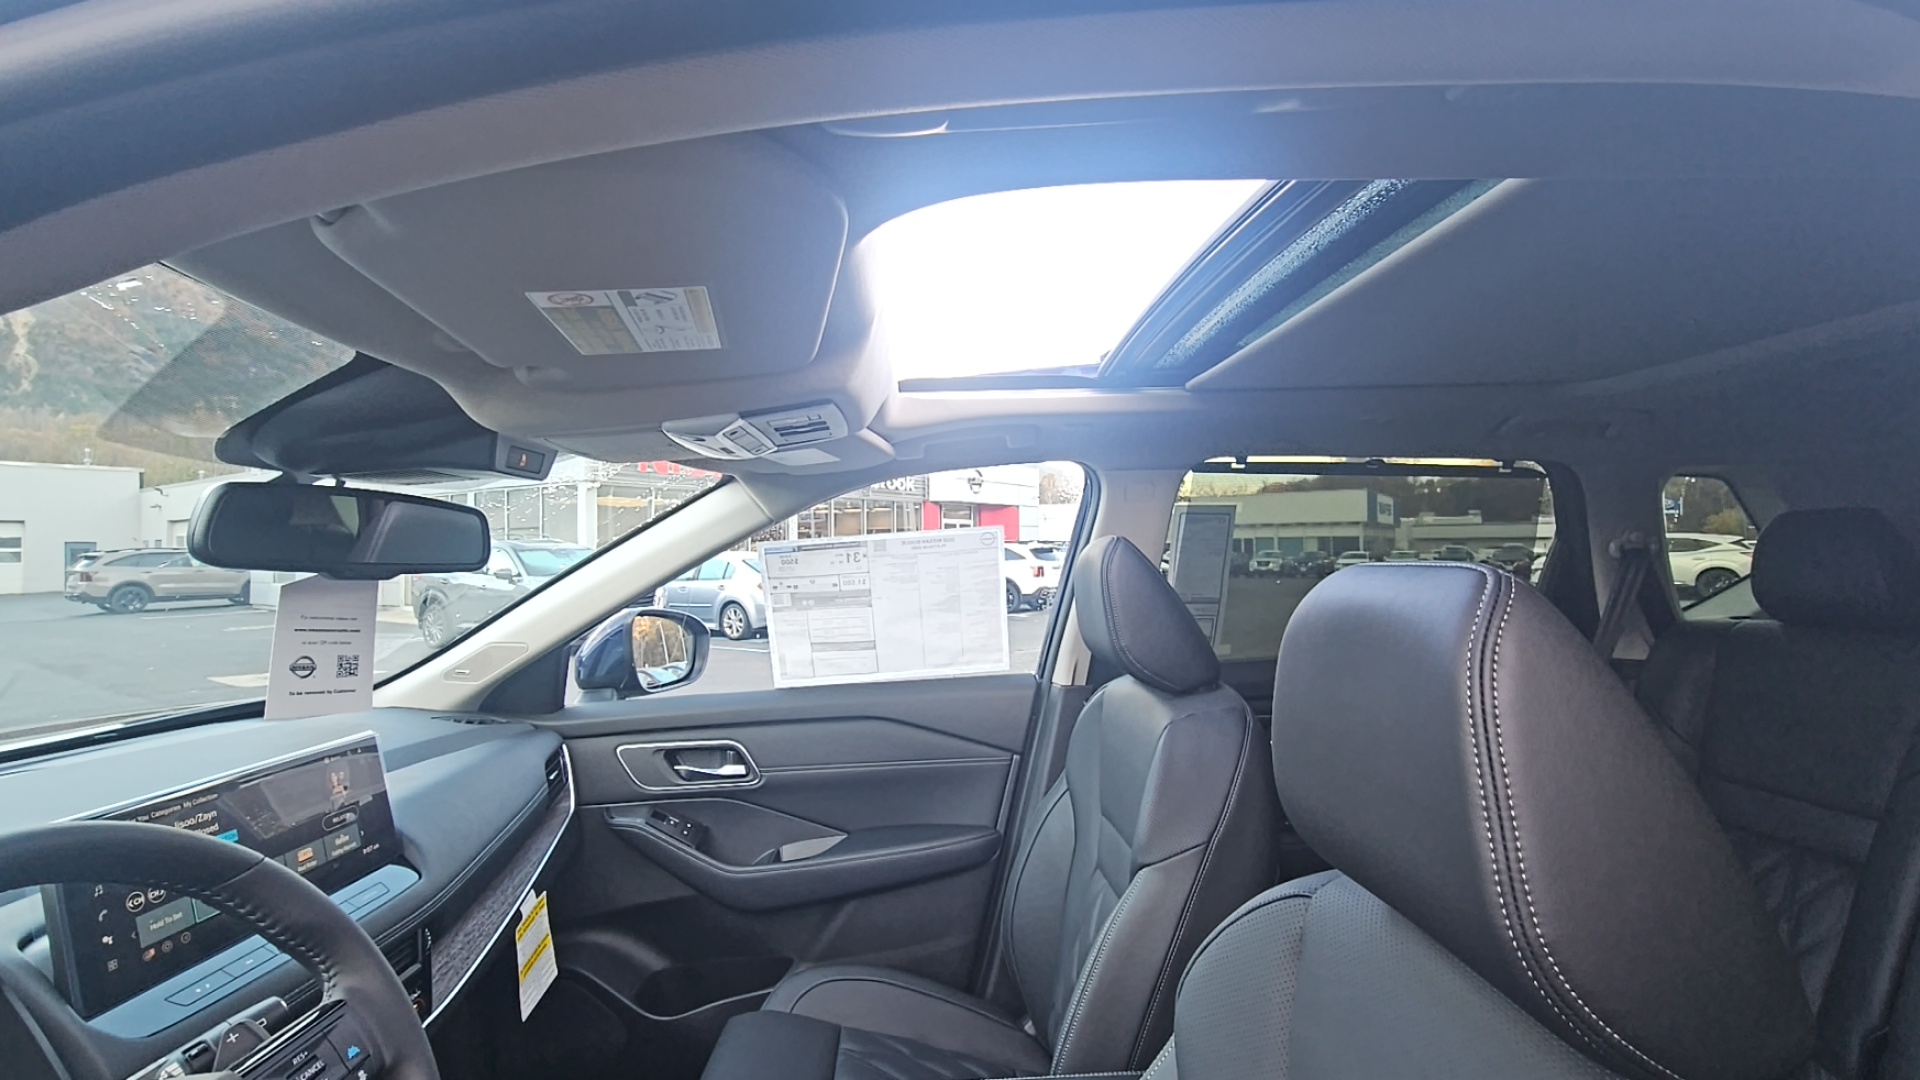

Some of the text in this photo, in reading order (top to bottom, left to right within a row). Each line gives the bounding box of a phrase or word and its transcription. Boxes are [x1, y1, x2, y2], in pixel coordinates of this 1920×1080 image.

[871, 475, 916, 492] OOK
[150, 804, 182, 818] Categories
[182, 801, 192, 809] My
[192, 793, 218, 806] Collection
[195, 822, 220, 835] losed
[149, 911, 183, 931] Hold To Set
[300, 1060, 326, 1080] CANCEL
